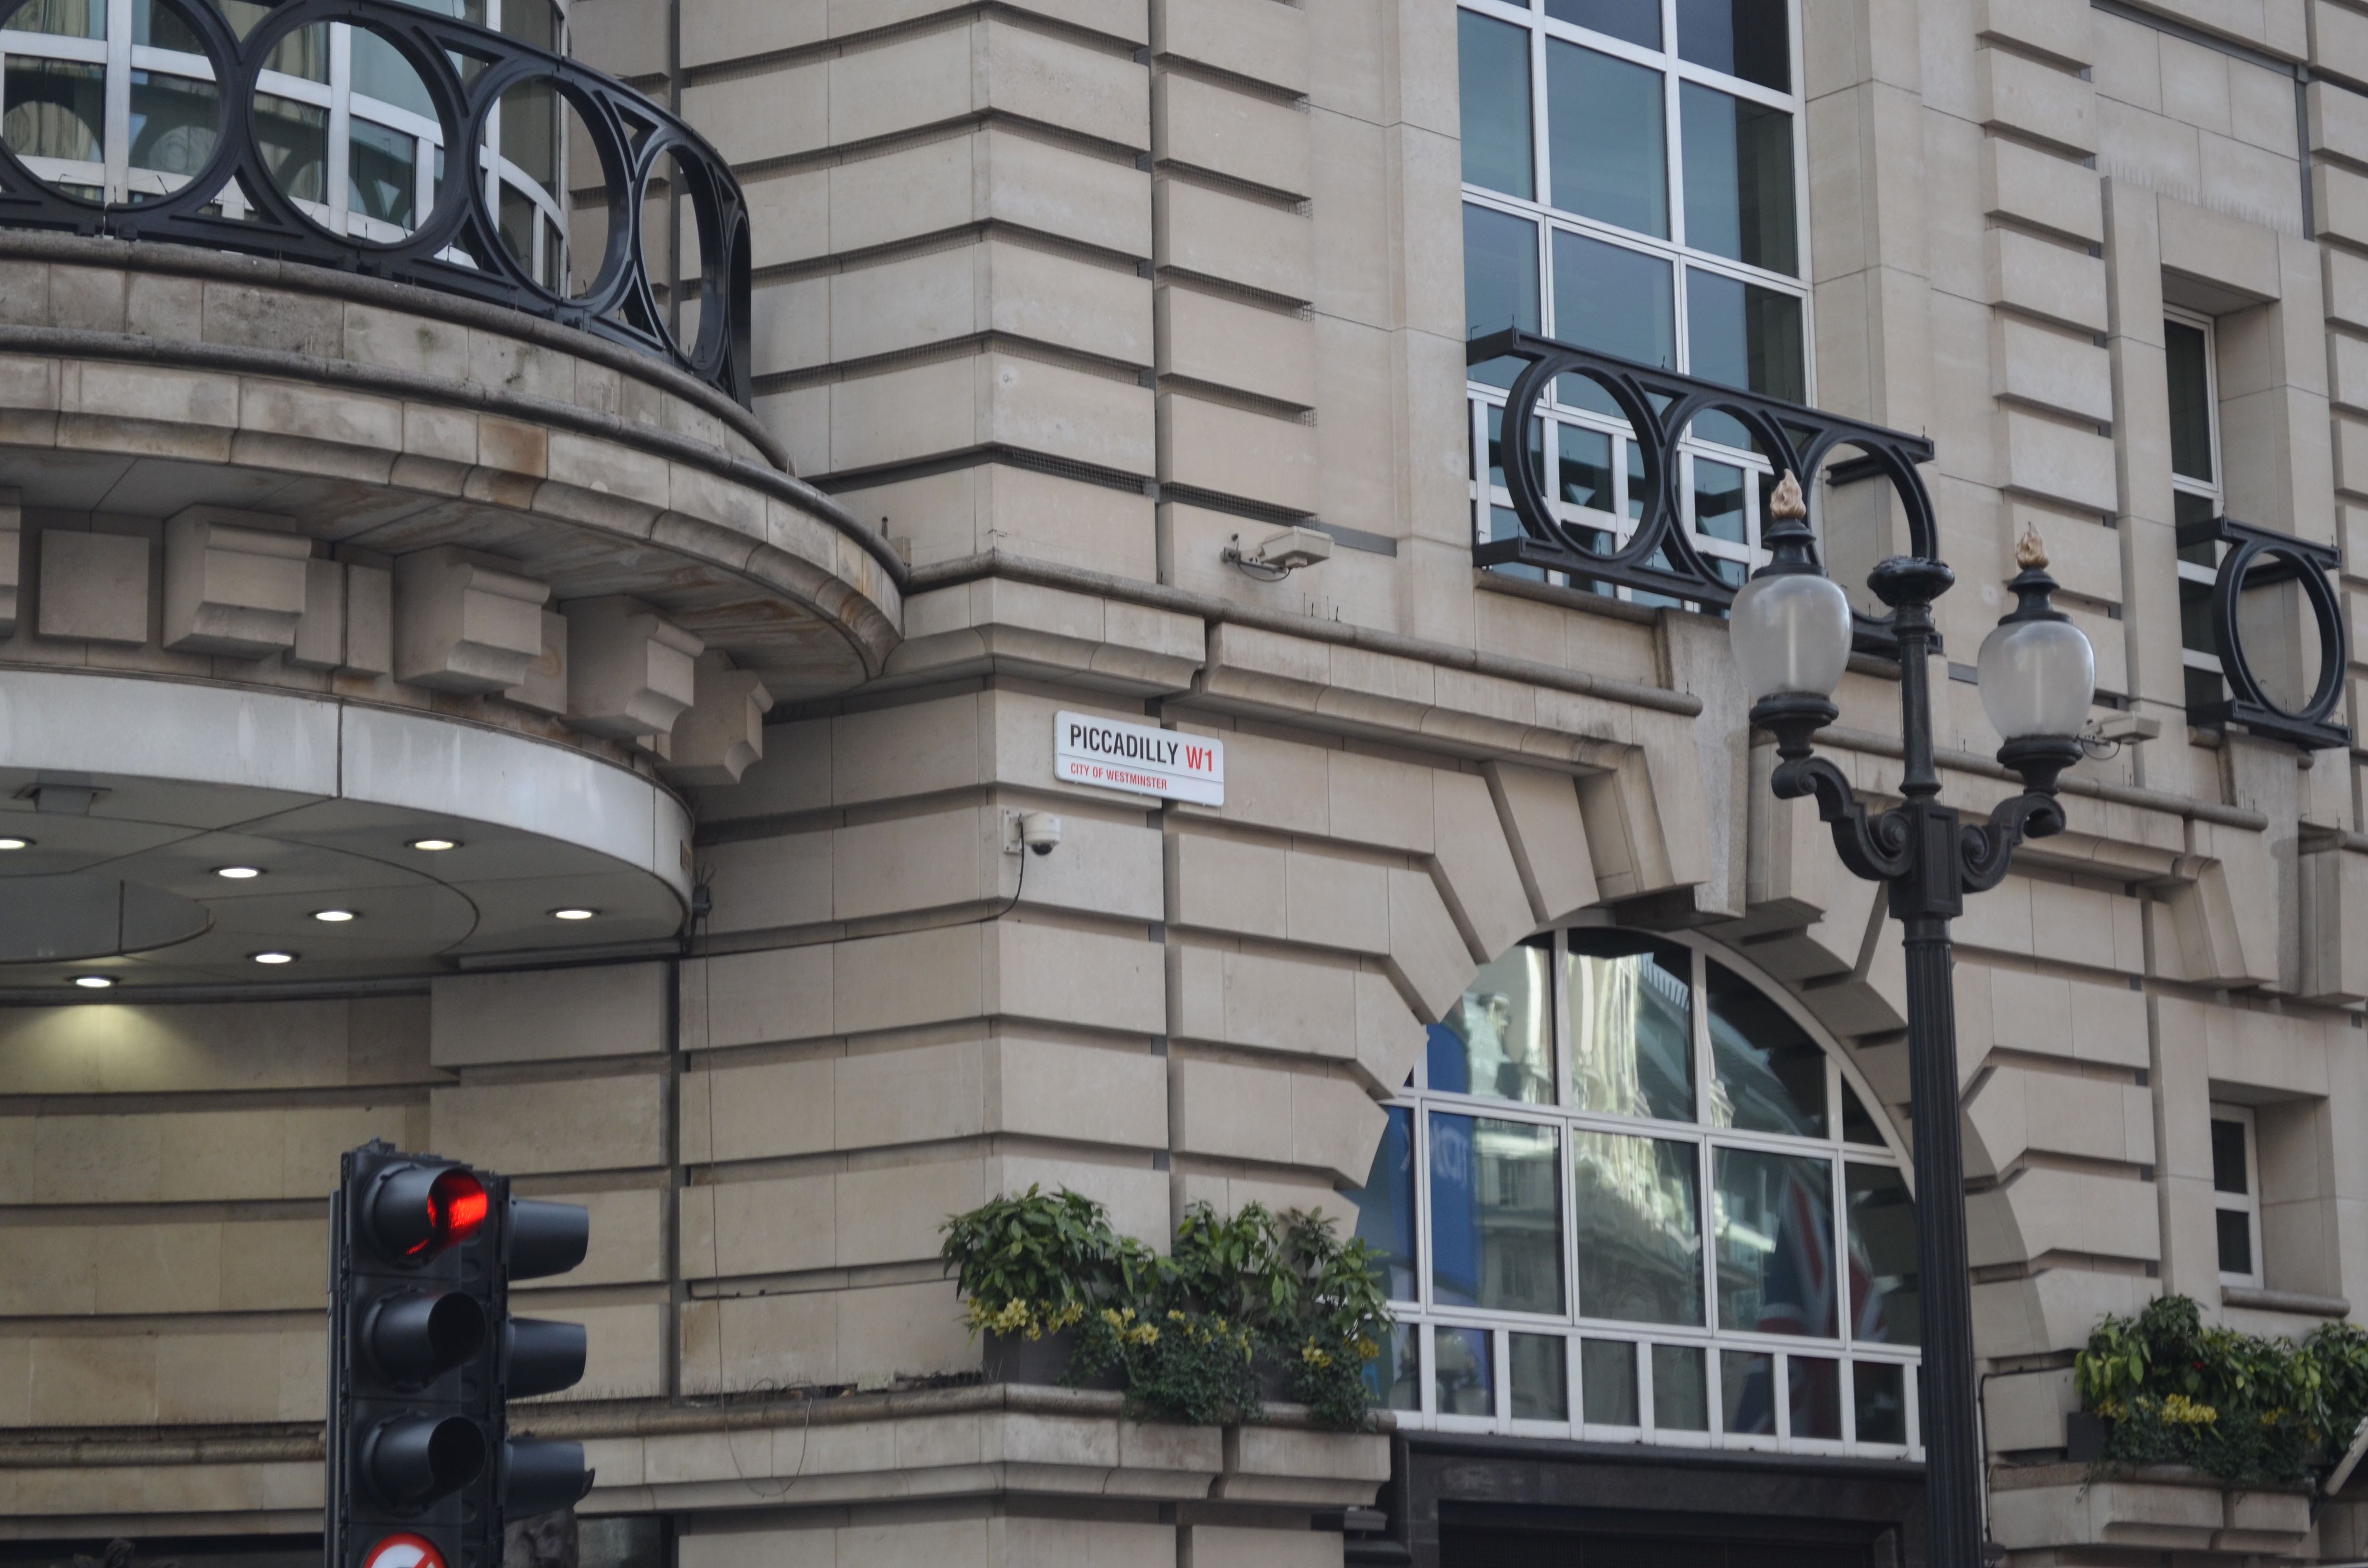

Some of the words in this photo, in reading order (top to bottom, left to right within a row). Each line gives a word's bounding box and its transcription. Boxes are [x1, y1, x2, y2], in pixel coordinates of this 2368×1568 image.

[1070, 723, 1178, 765] PICCADILLY
[1185, 744, 1213, 772] W1
[1071, 762, 1089, 775] CITY
[1092, 766, 1103, 779] OF
[1106, 769, 1168, 790] WESTMINSTER
